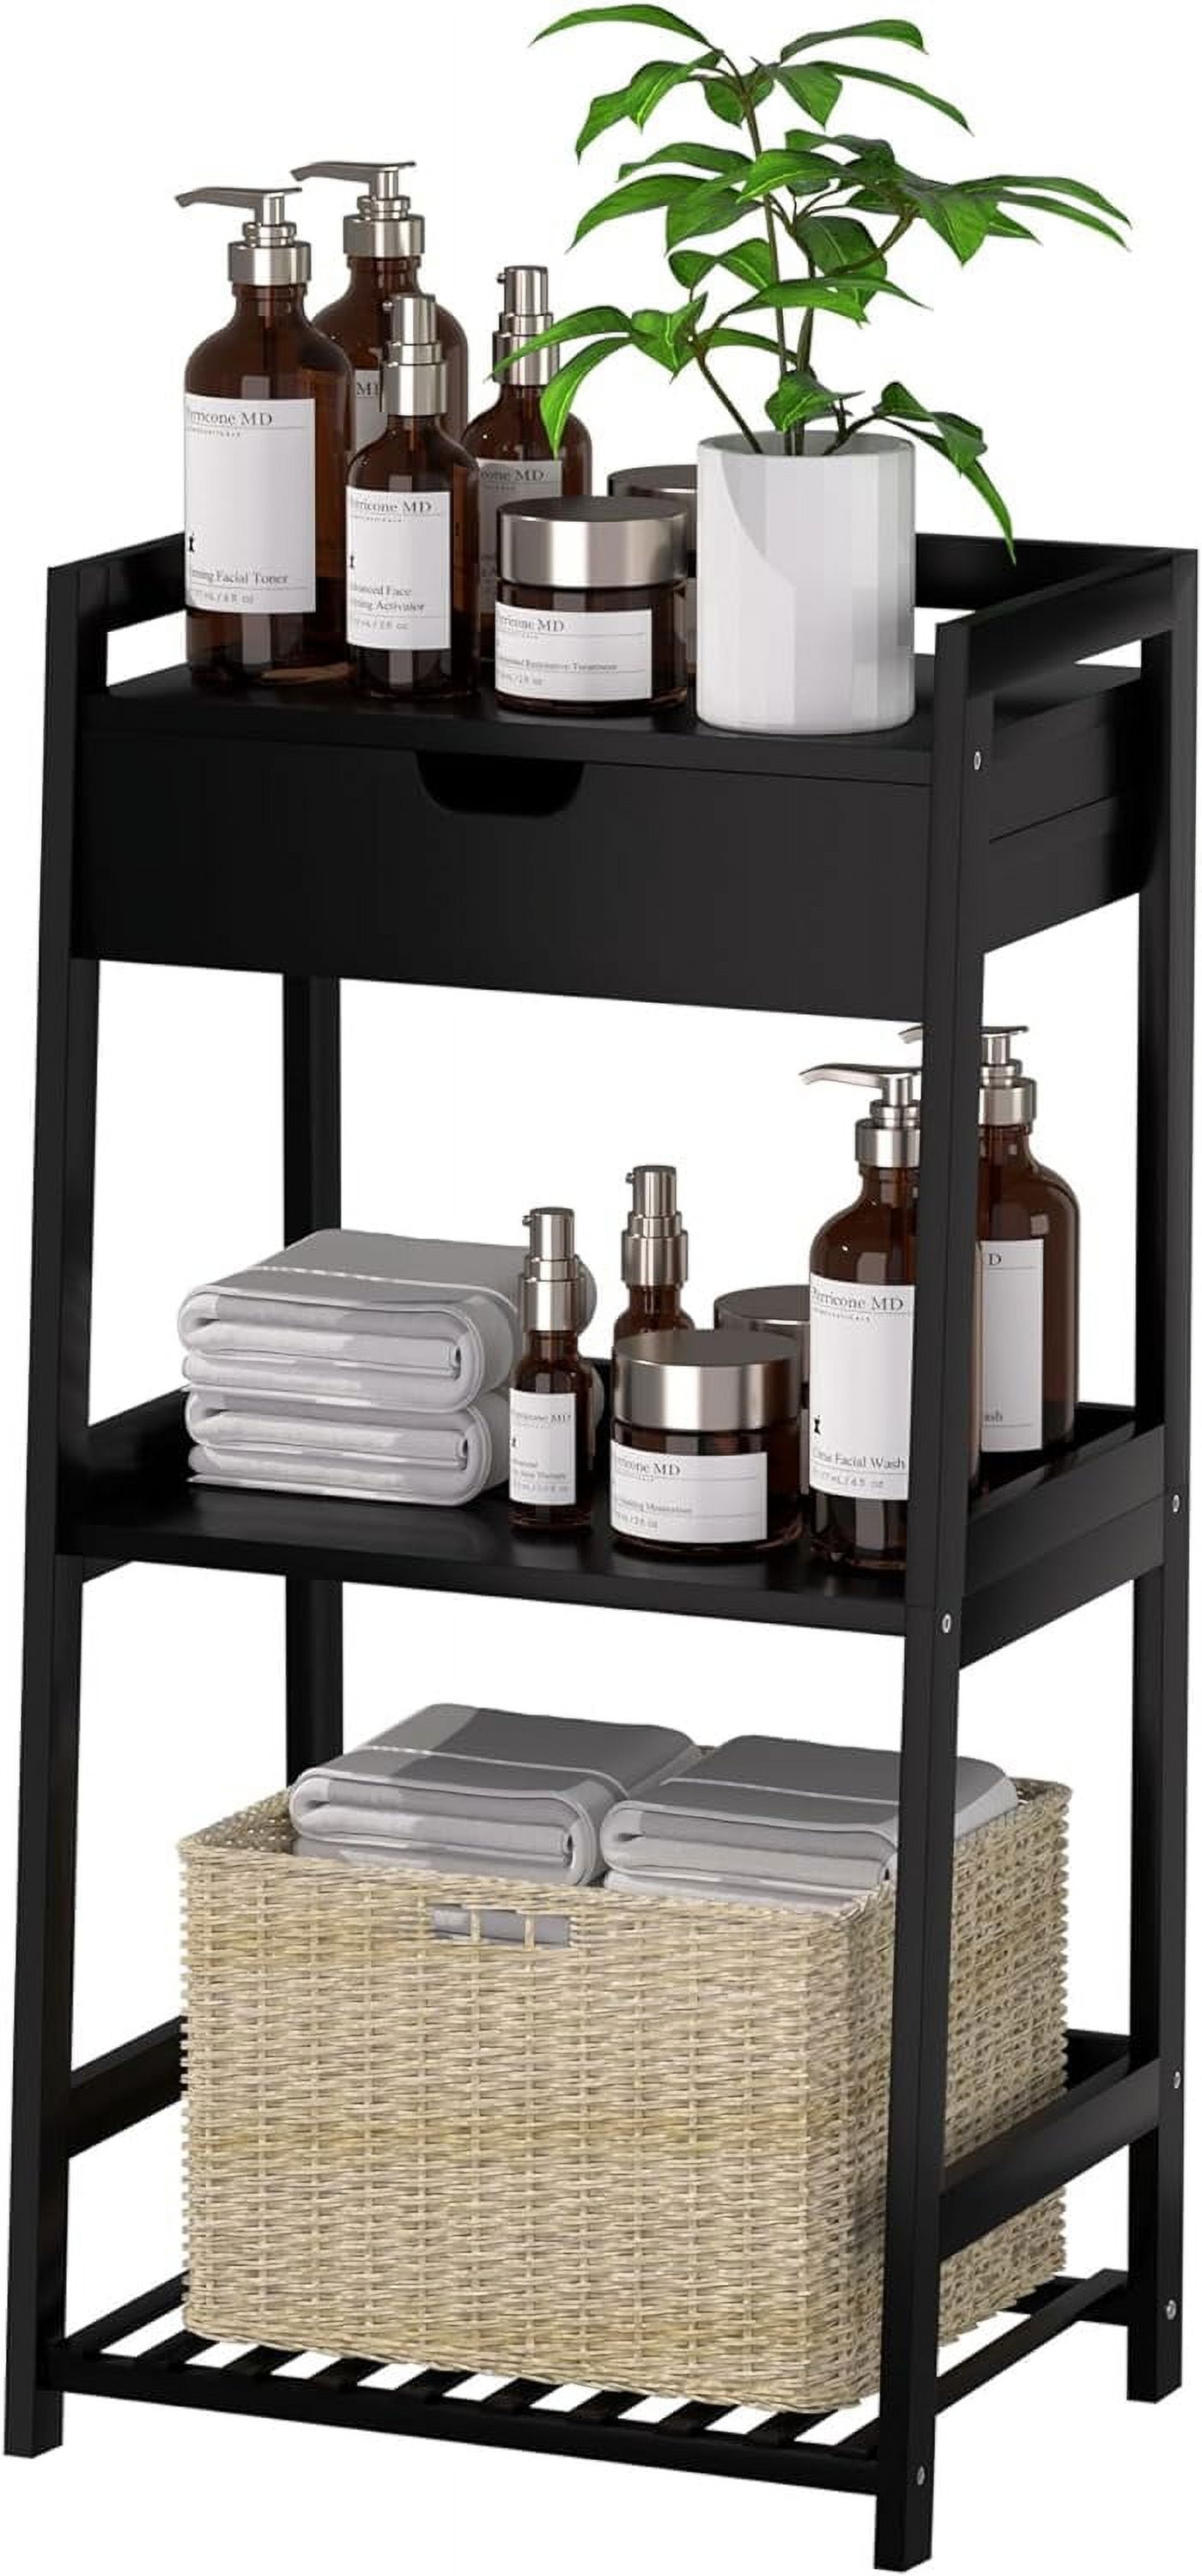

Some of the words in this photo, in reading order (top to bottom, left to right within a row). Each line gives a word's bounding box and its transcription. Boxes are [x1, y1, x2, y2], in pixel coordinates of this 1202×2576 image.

[240, 411, 273, 426] MD
[514, 469, 544, 482] MD
[403, 501, 432, 513] MD
[216, 569, 249, 586] Facial
[252, 570, 289, 586] Toner
[537, 617, 565, 633] MD
[871, 1295, 904, 1311] MD
[653, 1461, 682, 1476] MD
[870, 1455, 907, 1471] Wash
